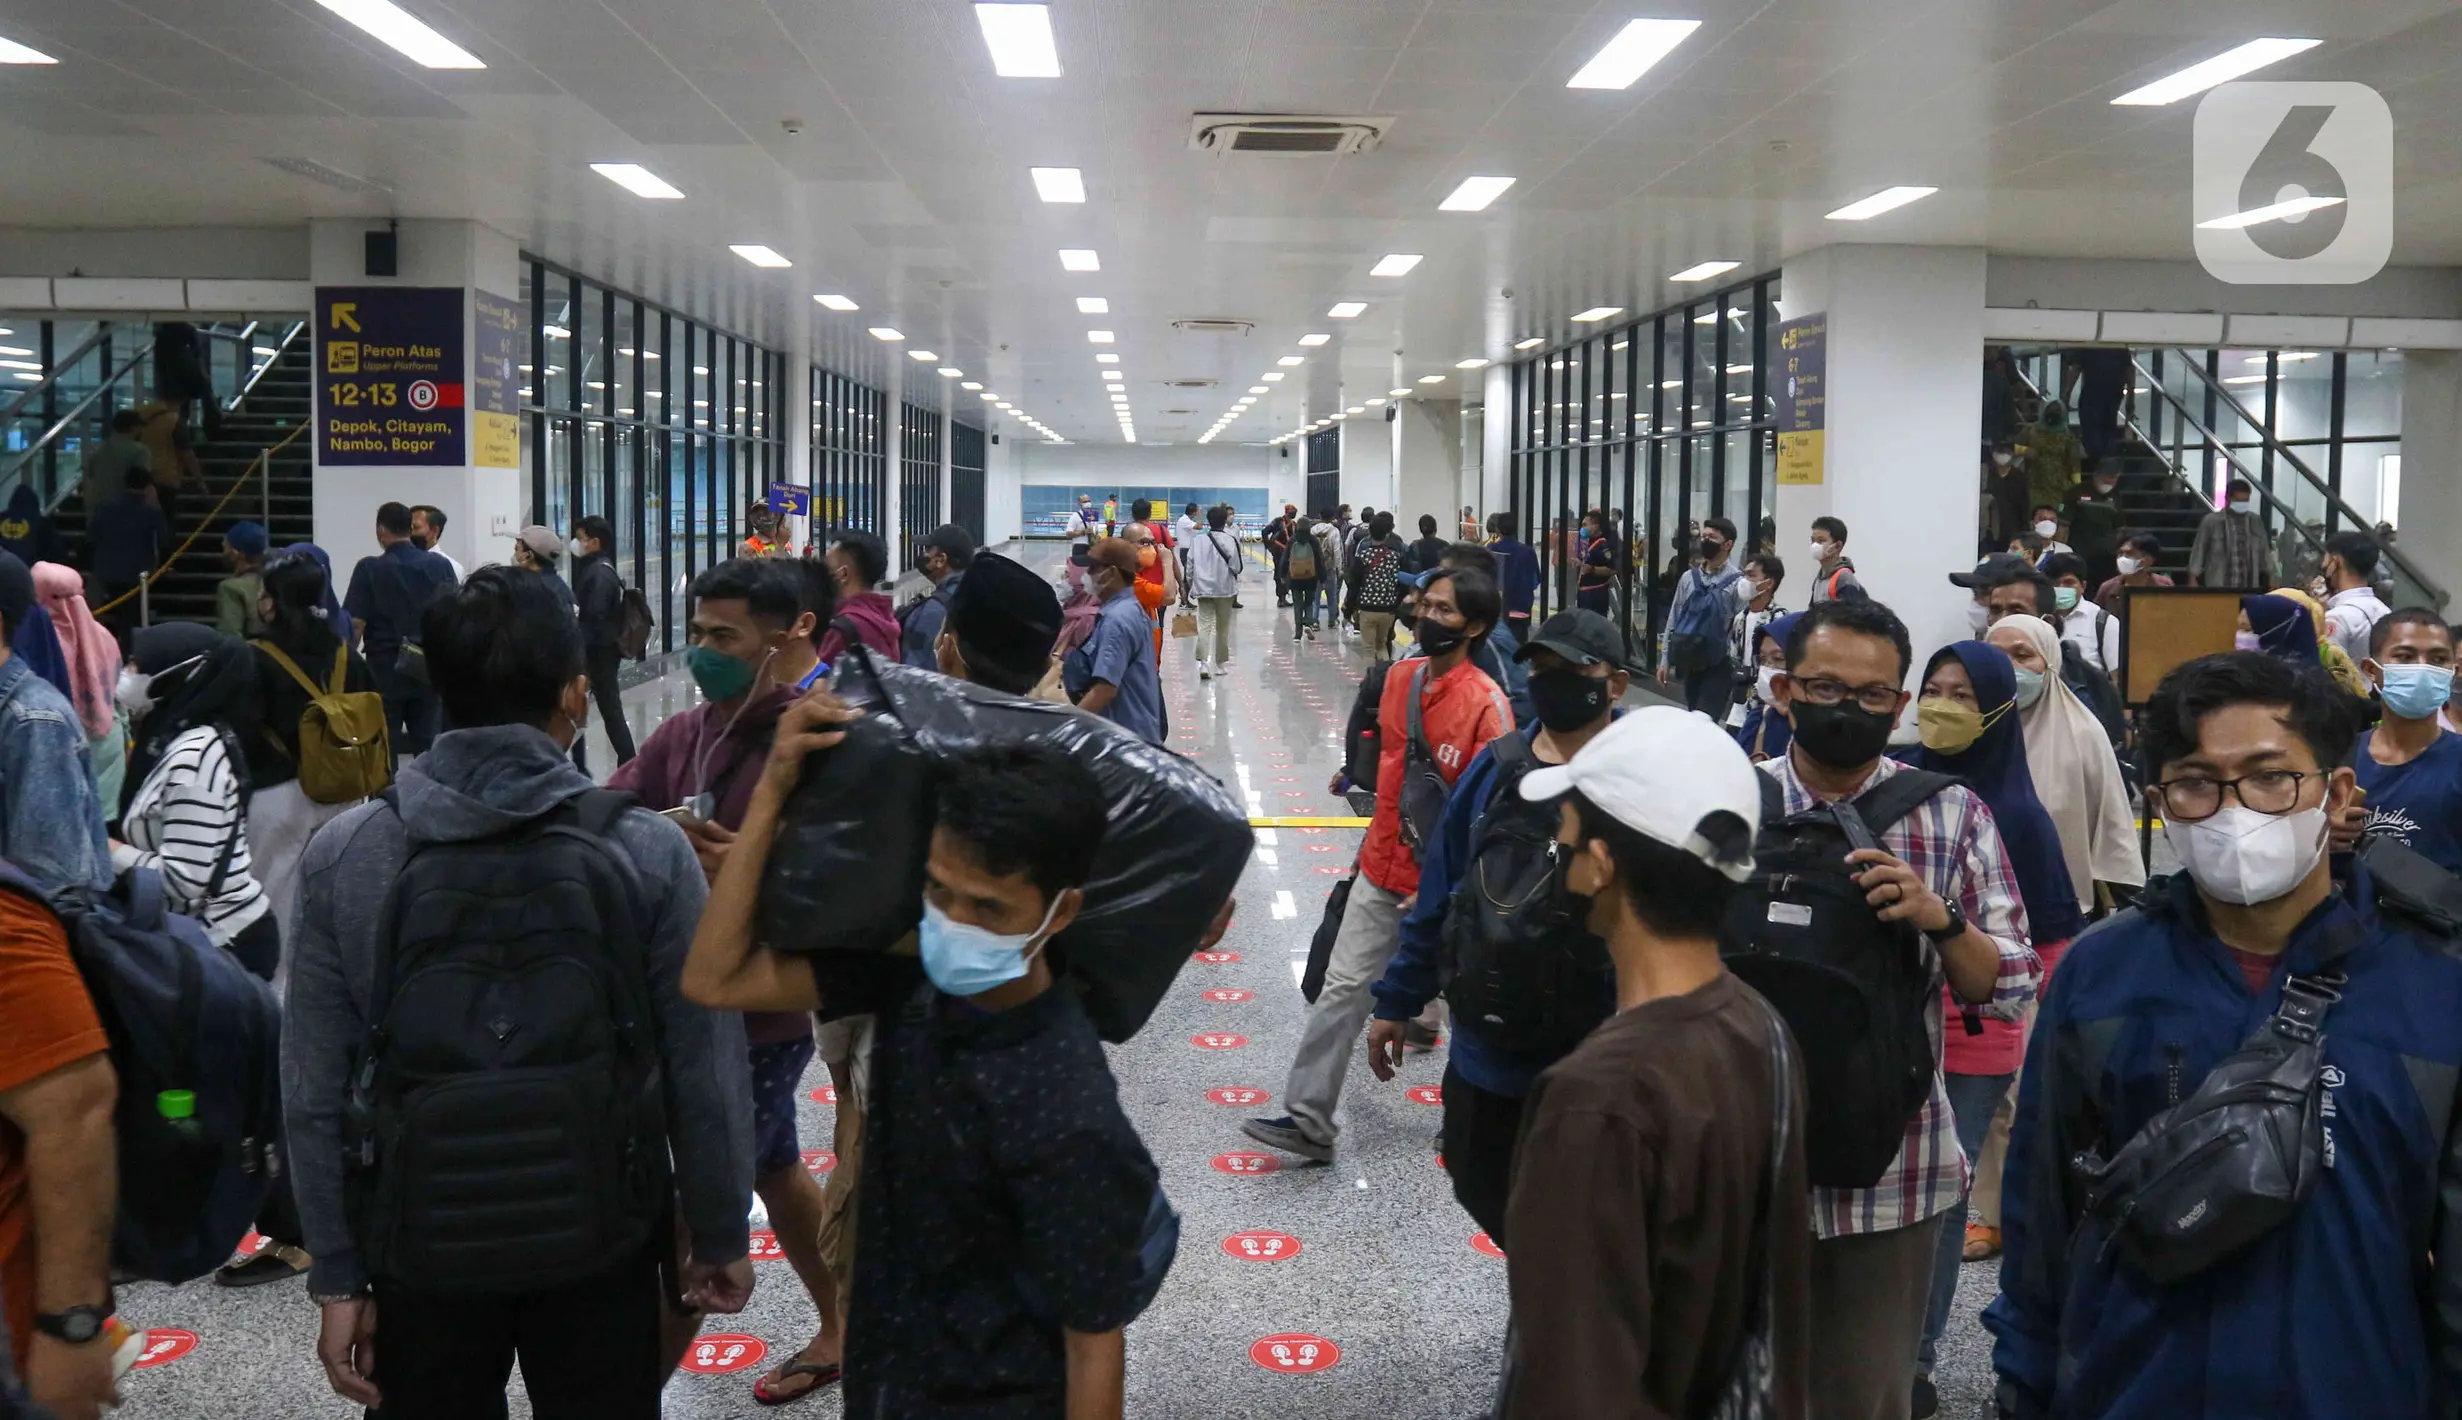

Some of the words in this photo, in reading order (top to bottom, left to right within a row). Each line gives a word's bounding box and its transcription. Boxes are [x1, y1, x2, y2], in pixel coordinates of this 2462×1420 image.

[363, 344, 404, 358] Peron
[408, 344, 441, 358] Atas
[363, 361, 392, 372] Upper
[394, 361, 438, 371] Platforms
[419, 390, 427, 400] B
[330, 419, 382, 436] Depok,
[386, 419, 452, 436] Citayam,
[330, 438, 387, 453] Nambo,
[391, 438, 435, 454] Bogor
